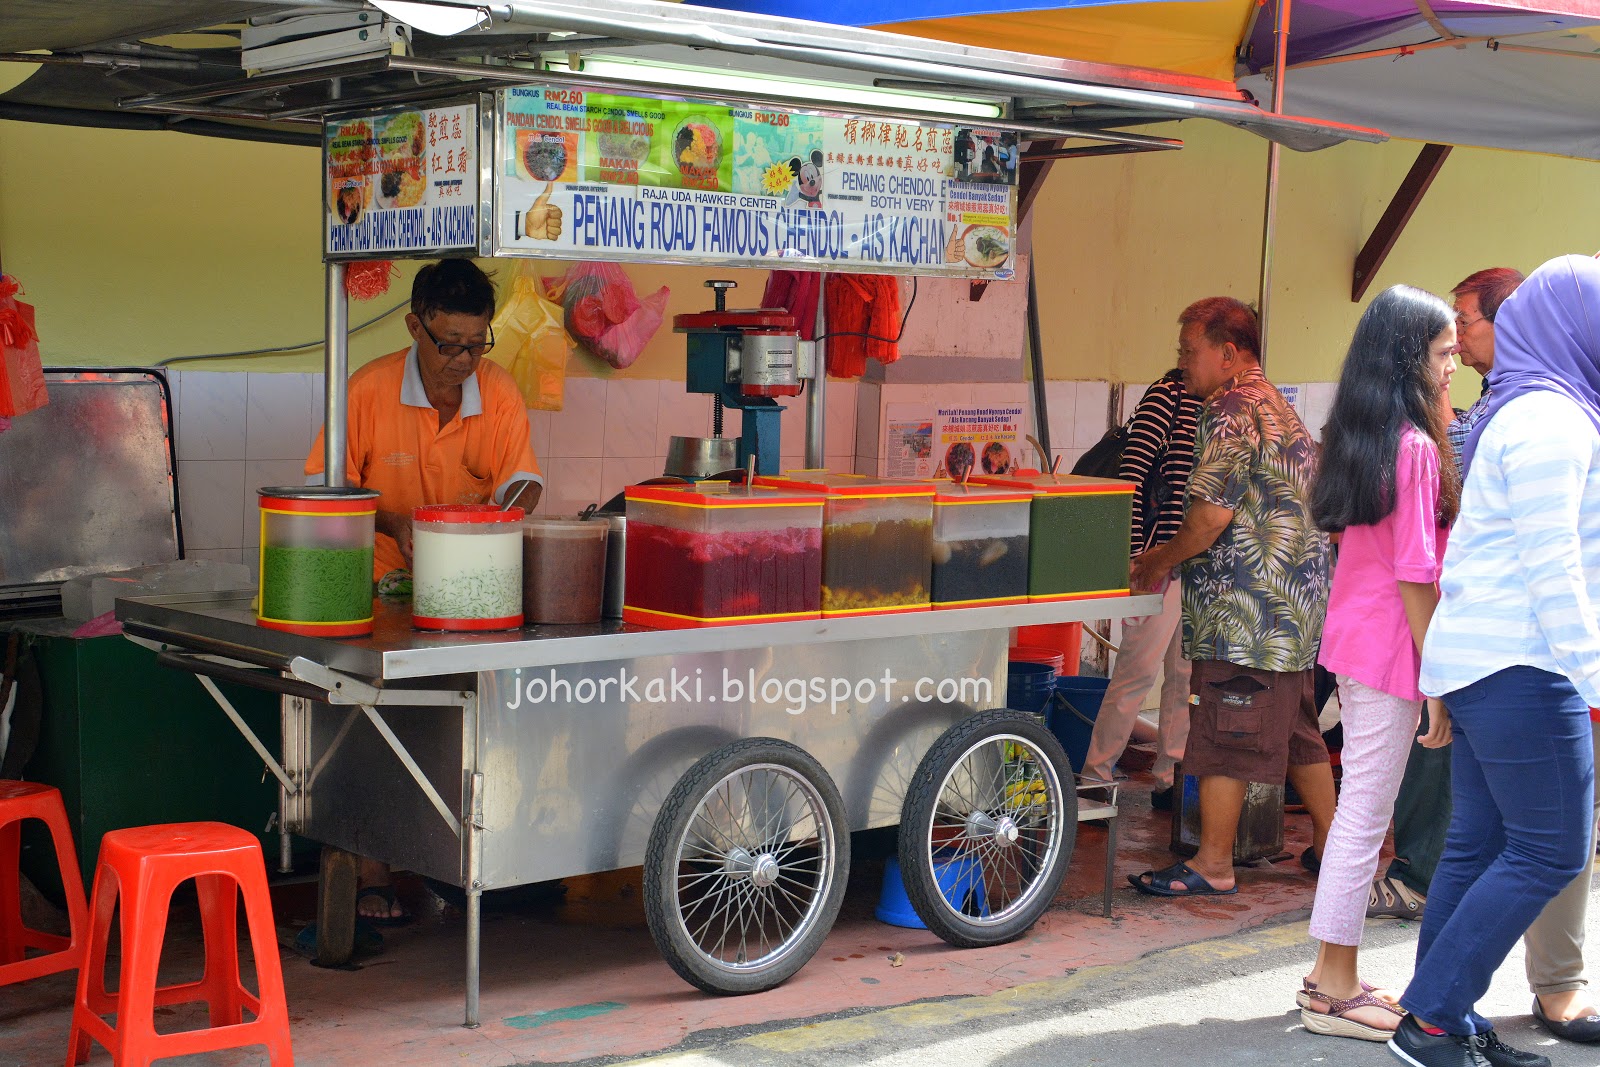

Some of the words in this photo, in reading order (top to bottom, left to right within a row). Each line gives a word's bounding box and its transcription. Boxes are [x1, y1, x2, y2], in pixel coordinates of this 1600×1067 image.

[512, 88, 540, 98] BUNGKUS
[544, 90, 583, 105] RM2.60
[546, 102, 561, 111] REAL
[562, 103, 579, 112] BEAN
[579, 105, 602, 114] STARCH
[626, 109, 648, 118] SMELLS
[649, 111, 666, 120] GOOD
[728, 109, 753, 119] BUNGKUS
[754, 112, 790, 127] RM2.60
[506, 111, 536, 129] PANDAN
[536, 114, 564, 130] CENDOL
[565, 117, 592, 132] SMELLS
[593, 119, 612, 134] GOOD
[619, 120, 654, 137] DELICIOUS
[599, 157, 639, 170] MAKAN
[680, 165, 718, 177] MAKAN
[842, 171, 886, 194] PENANG
[888, 175, 938, 198] CHENDOL
[642, 188, 669, 201] RAJA
[671, 191, 692, 203] UDA
[694, 192, 737, 207] HAWKER
[739, 196, 778, 210] CENTER
[870, 195, 902, 210] BOTH
[905, 198, 934, 212] VERY
[372, 209, 396, 250] FAMOUS
[398, 207, 427, 248] CHENDOL
[431, 206, 442, 247] AIS
[444, 204, 475, 246] KACHANG
[573, 193, 645, 250] PENANG
[650, 201, 697, 252] ROAD
[702, 206, 769, 257] FAMOUS
[775, 208, 849, 261] CHENDOL
[861, 212, 885, 263] AIS
